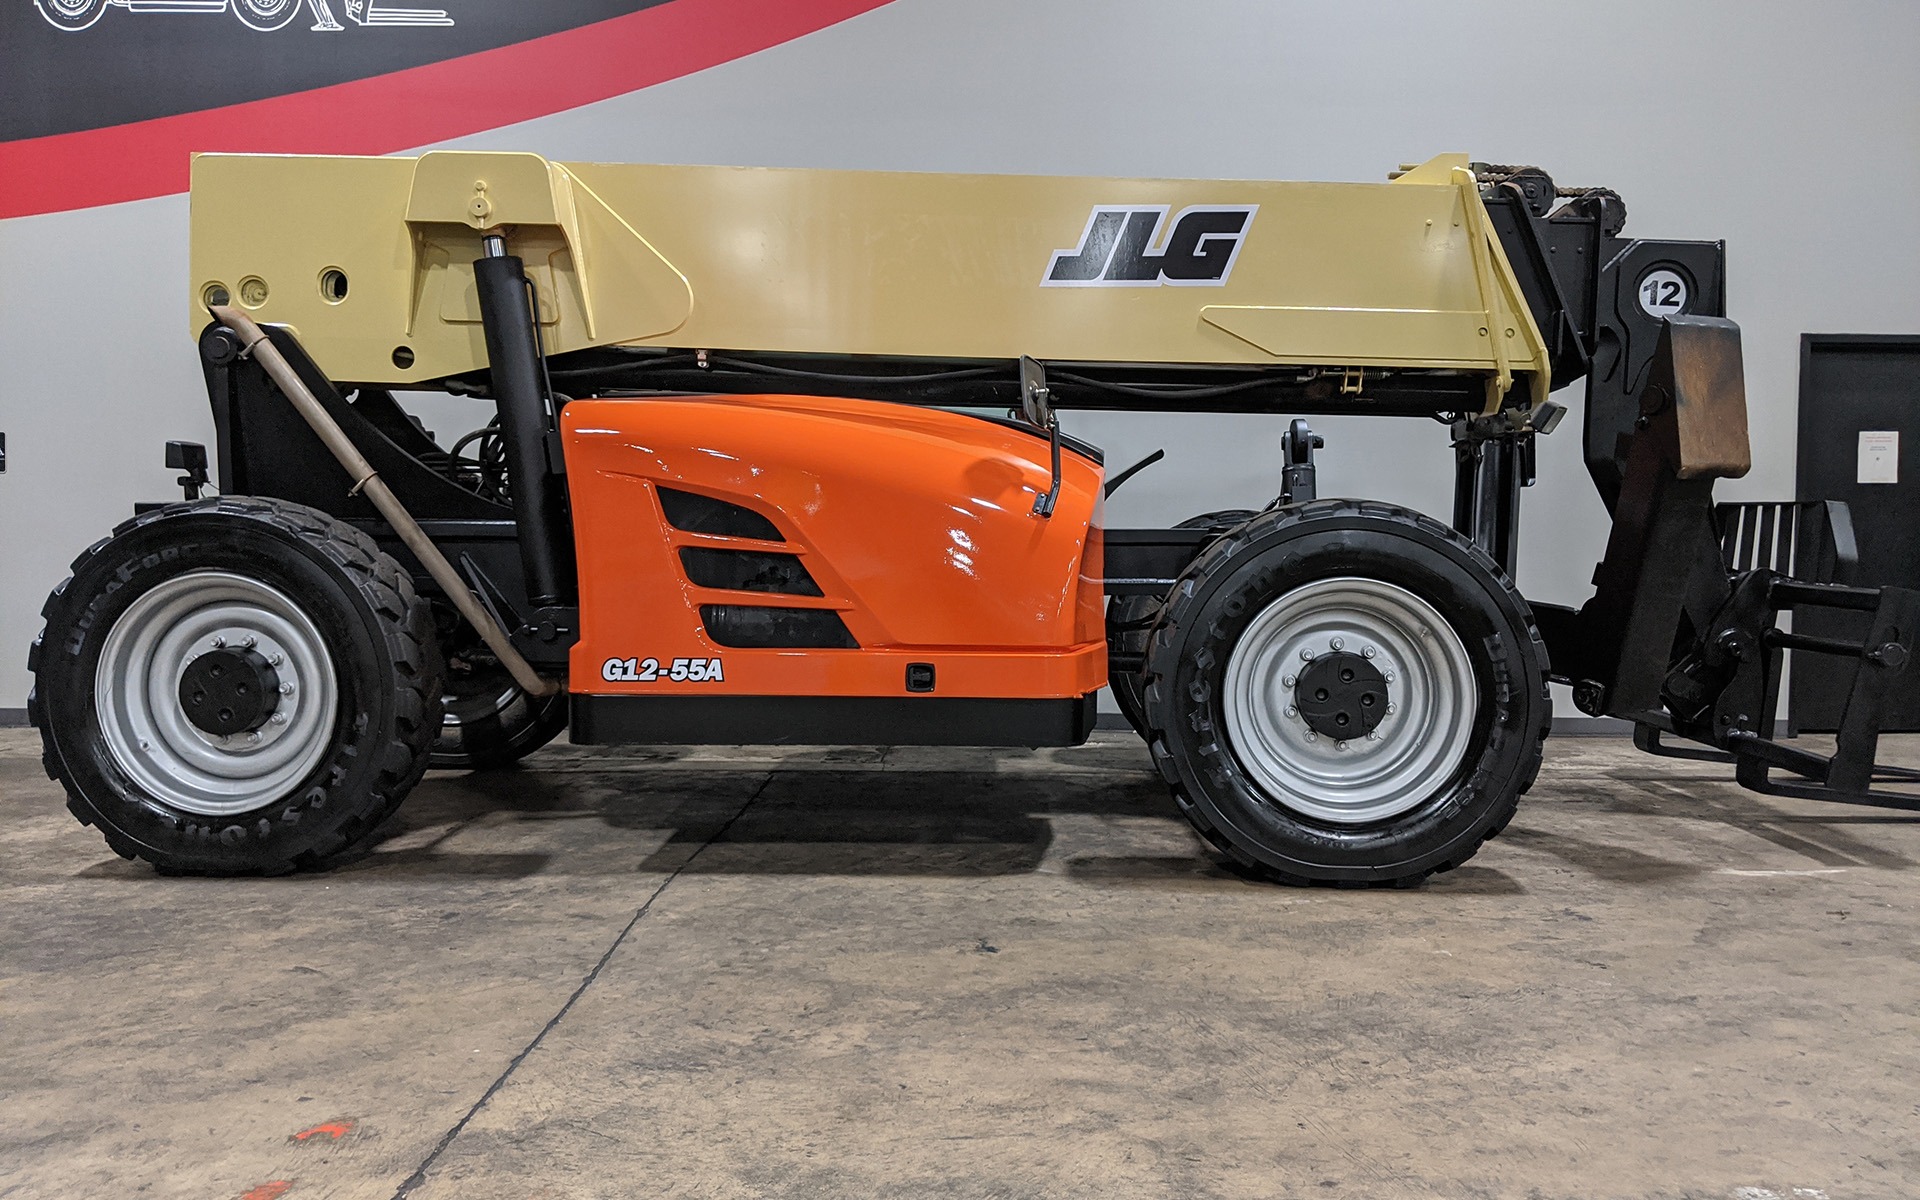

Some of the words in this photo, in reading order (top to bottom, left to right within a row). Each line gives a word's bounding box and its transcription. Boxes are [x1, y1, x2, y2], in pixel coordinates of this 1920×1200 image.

[1044, 208, 1255, 284] JLG
[1643, 280, 1681, 307] 12
[602, 657, 725, 682] G12-55A
